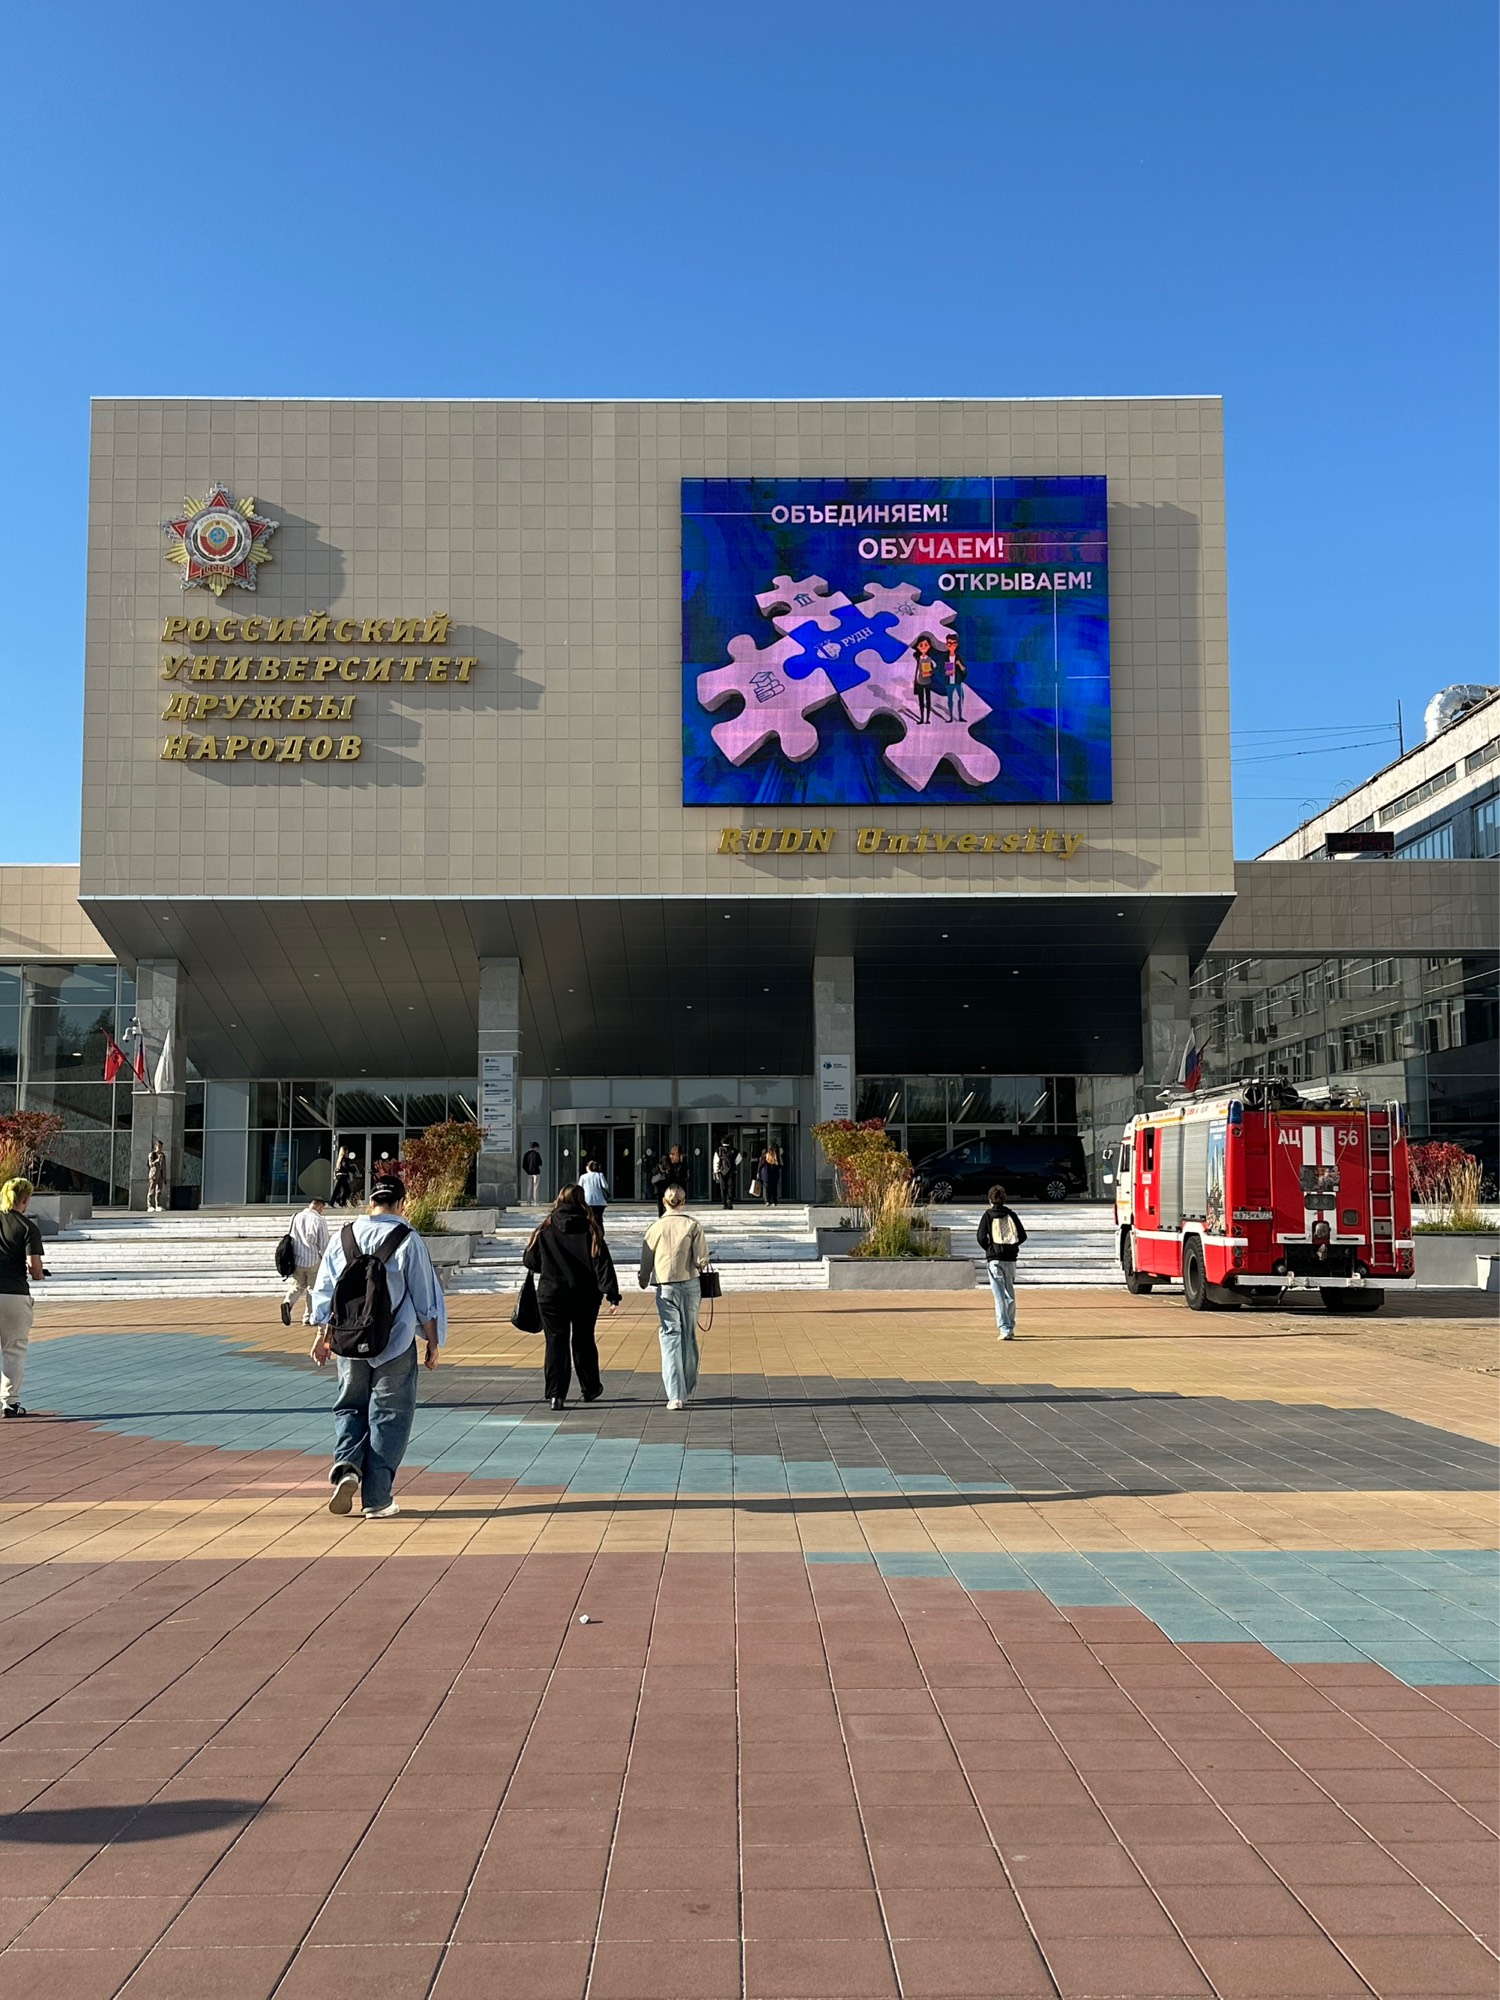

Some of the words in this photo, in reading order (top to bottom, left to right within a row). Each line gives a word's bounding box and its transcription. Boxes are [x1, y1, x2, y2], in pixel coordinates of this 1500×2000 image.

[771, 504, 948, 526] ОБЪЕДИНЯЕМ!
[858, 537, 1004, 559] ОБУЧАЕМ!
[206, 564, 230, 574] СССР
[938, 572, 1092, 591] ОТКРЫВАЕМ!
[160, 610, 452, 643] РОССИЙСКИЙ
[841, 627, 875, 647] РУДН
[160, 656, 478, 683] УНИВЕРСИТЕТ
[160, 693, 357, 720] ДРУЖБЫ
[160, 735, 363, 762] НАРОДОВ
[716, 828, 837, 854] RUDN
[856, 826, 1084, 859] University
[1278, 1129, 1301, 1148] АЦ
[1338, 1130, 1359, 1147] 56
